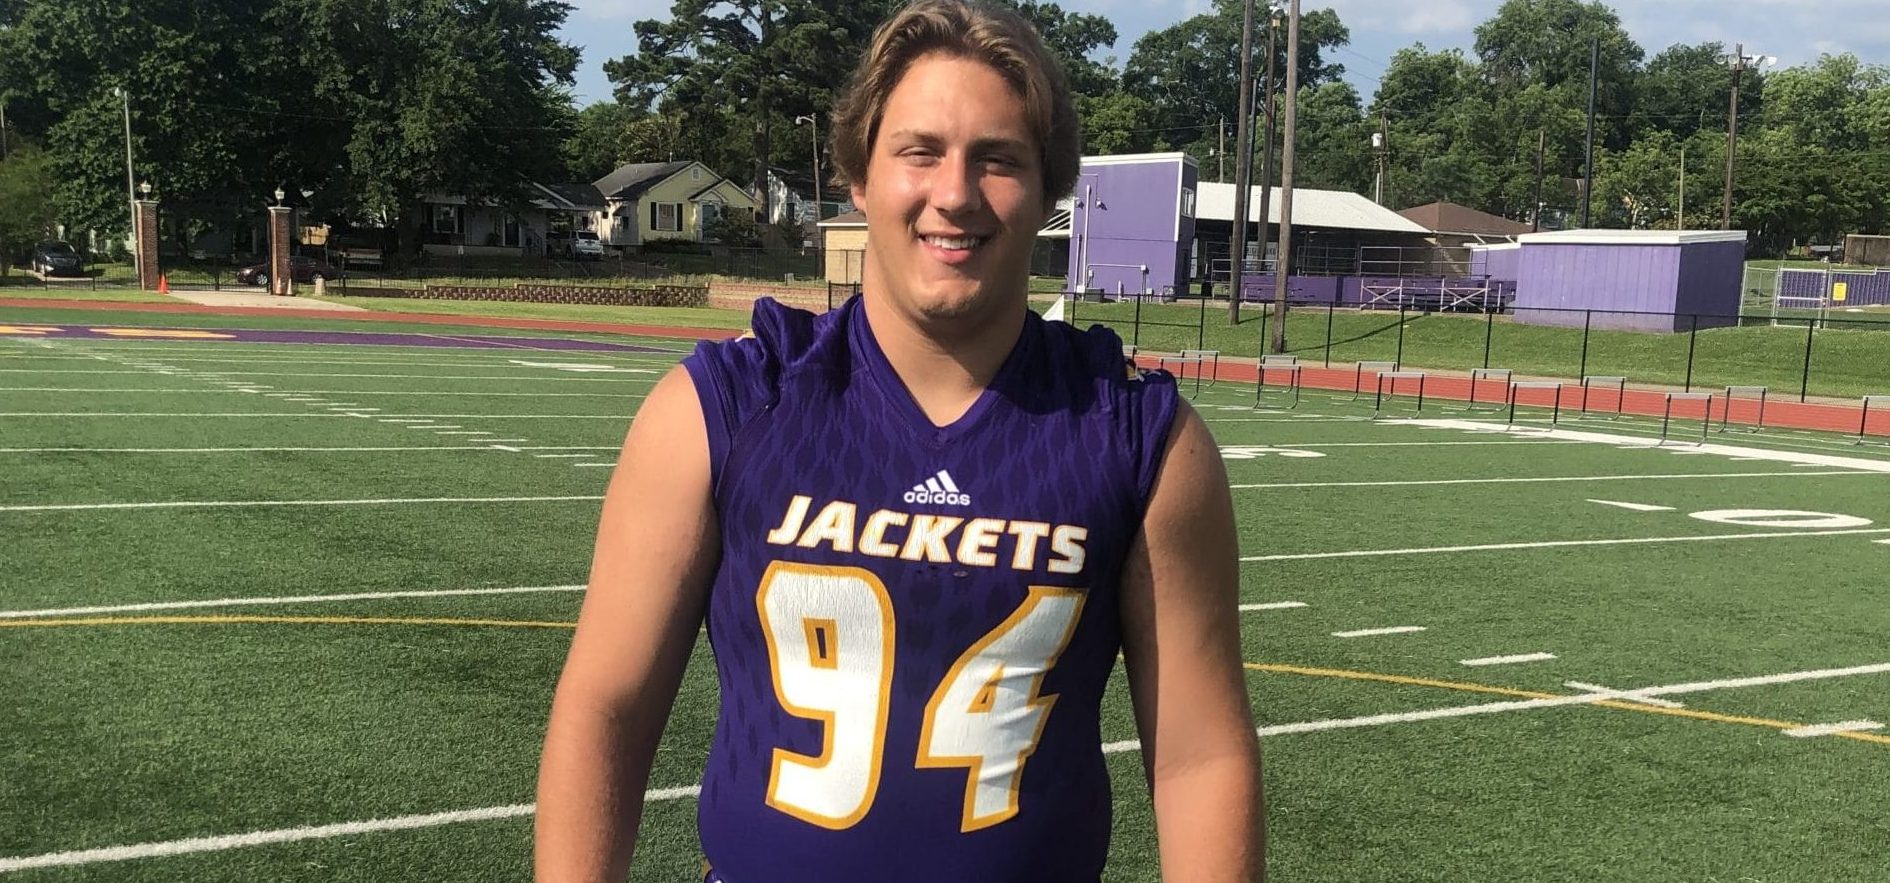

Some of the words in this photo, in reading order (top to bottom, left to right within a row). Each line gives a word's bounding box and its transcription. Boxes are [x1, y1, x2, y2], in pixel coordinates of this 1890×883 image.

[767, 495, 1088, 574] JACKETS
[903, 490, 971, 506] adidas
[756, 559, 1089, 833] 94
